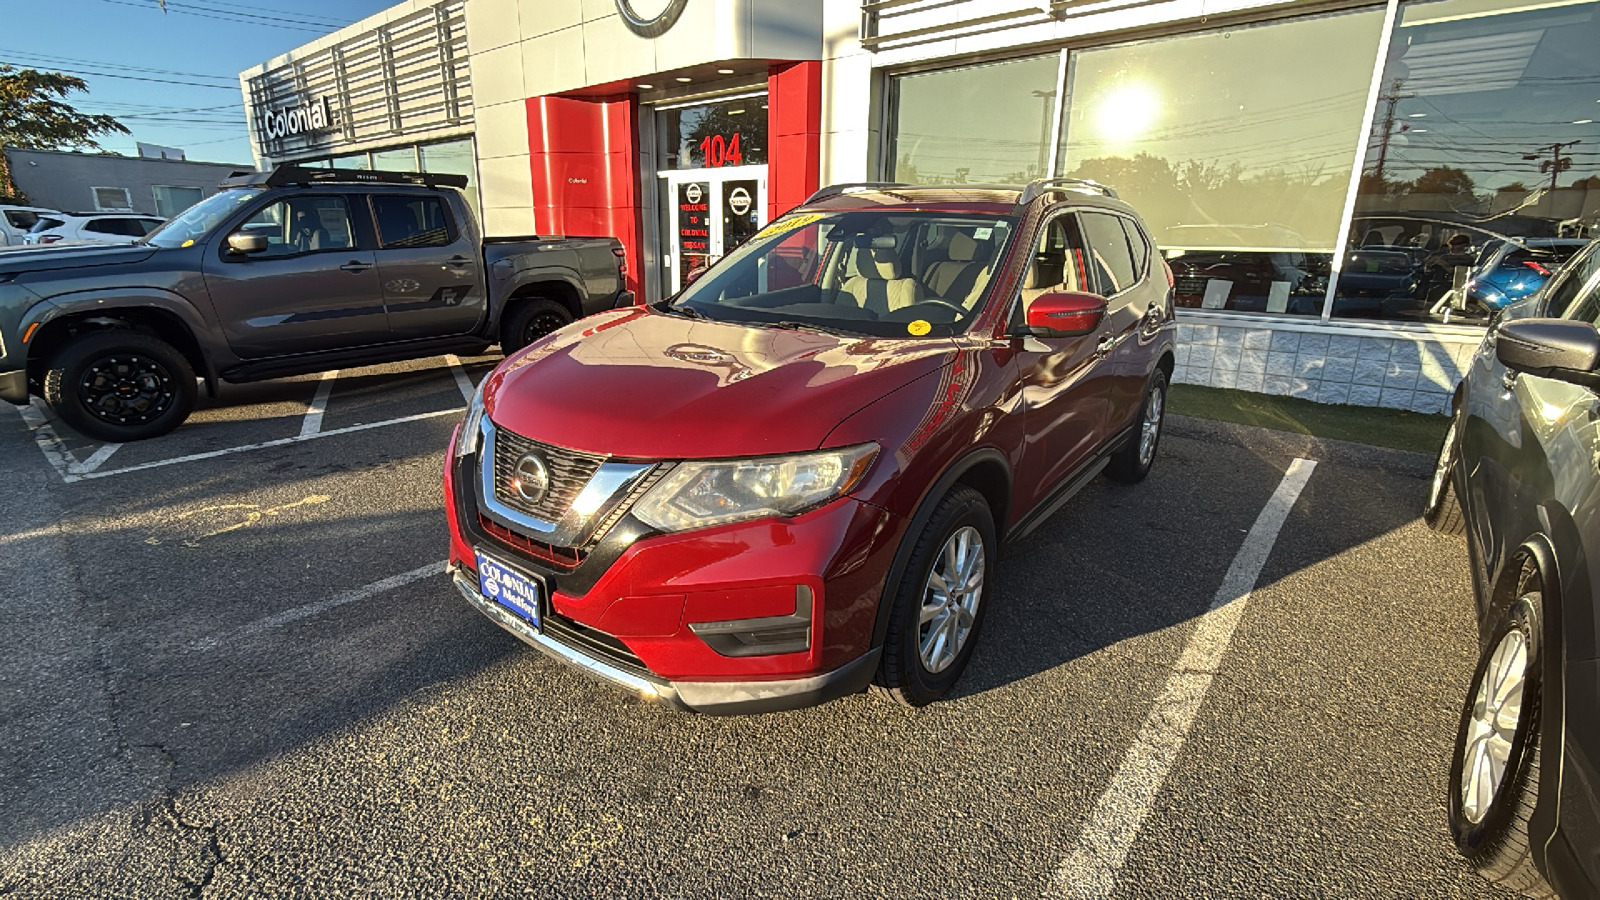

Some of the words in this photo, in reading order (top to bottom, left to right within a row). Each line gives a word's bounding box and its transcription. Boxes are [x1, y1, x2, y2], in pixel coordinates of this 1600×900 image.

[264, 95, 329, 138] Colonial
[700, 132, 742, 168] 104
[502, 586, 537, 618] Medford
